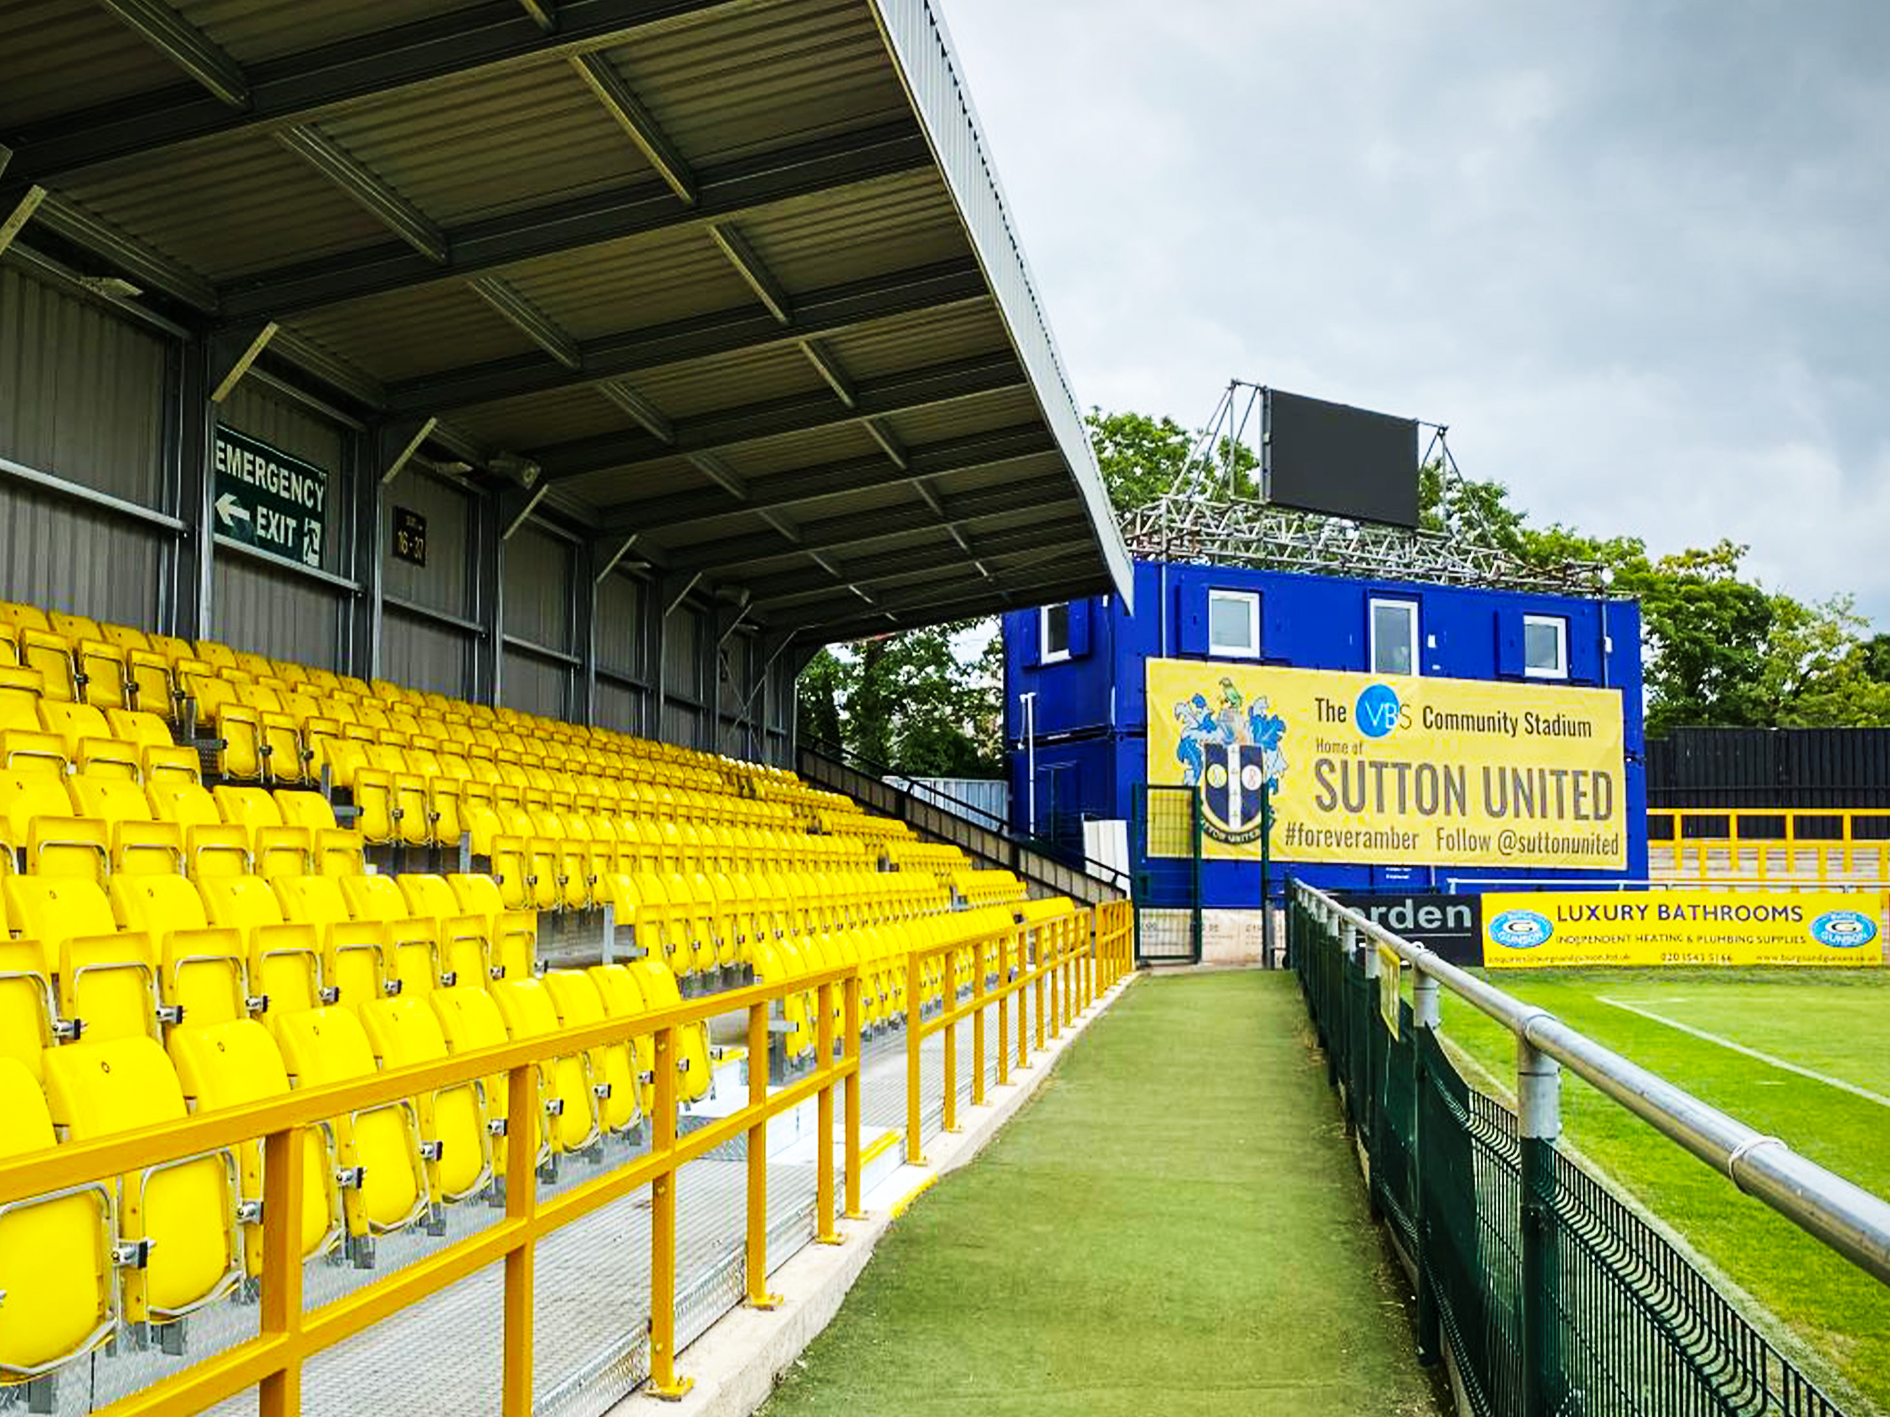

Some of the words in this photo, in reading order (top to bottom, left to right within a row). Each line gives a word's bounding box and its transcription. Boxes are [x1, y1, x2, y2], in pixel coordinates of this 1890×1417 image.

[215, 439, 325, 513] EMERGENCY
[256, 505, 297, 547] EXIT
[1314, 697, 1347, 723] The
[1364, 700, 1412, 730] VBS
[1422, 705, 1518, 738] Community
[1524, 711, 1592, 738] Stadium
[1315, 738, 1349, 754] Home
[1351, 740, 1364, 755] of
[1314, 758, 1467, 817] SUTTON
[1482, 765, 1613, 821] UNITED
[1285, 822, 1419, 850] #foreveramber
[1436, 827, 1492, 852] Follow
[1497, 829, 1620, 857] @suttonunited
[1556, 904, 1649, 922] LUXURY
[1657, 904, 1804, 922] BATHROOMS
[1696, 935, 1754, 944] PLUMBING
[1756, 935, 1806, 944] SUPPLIES
